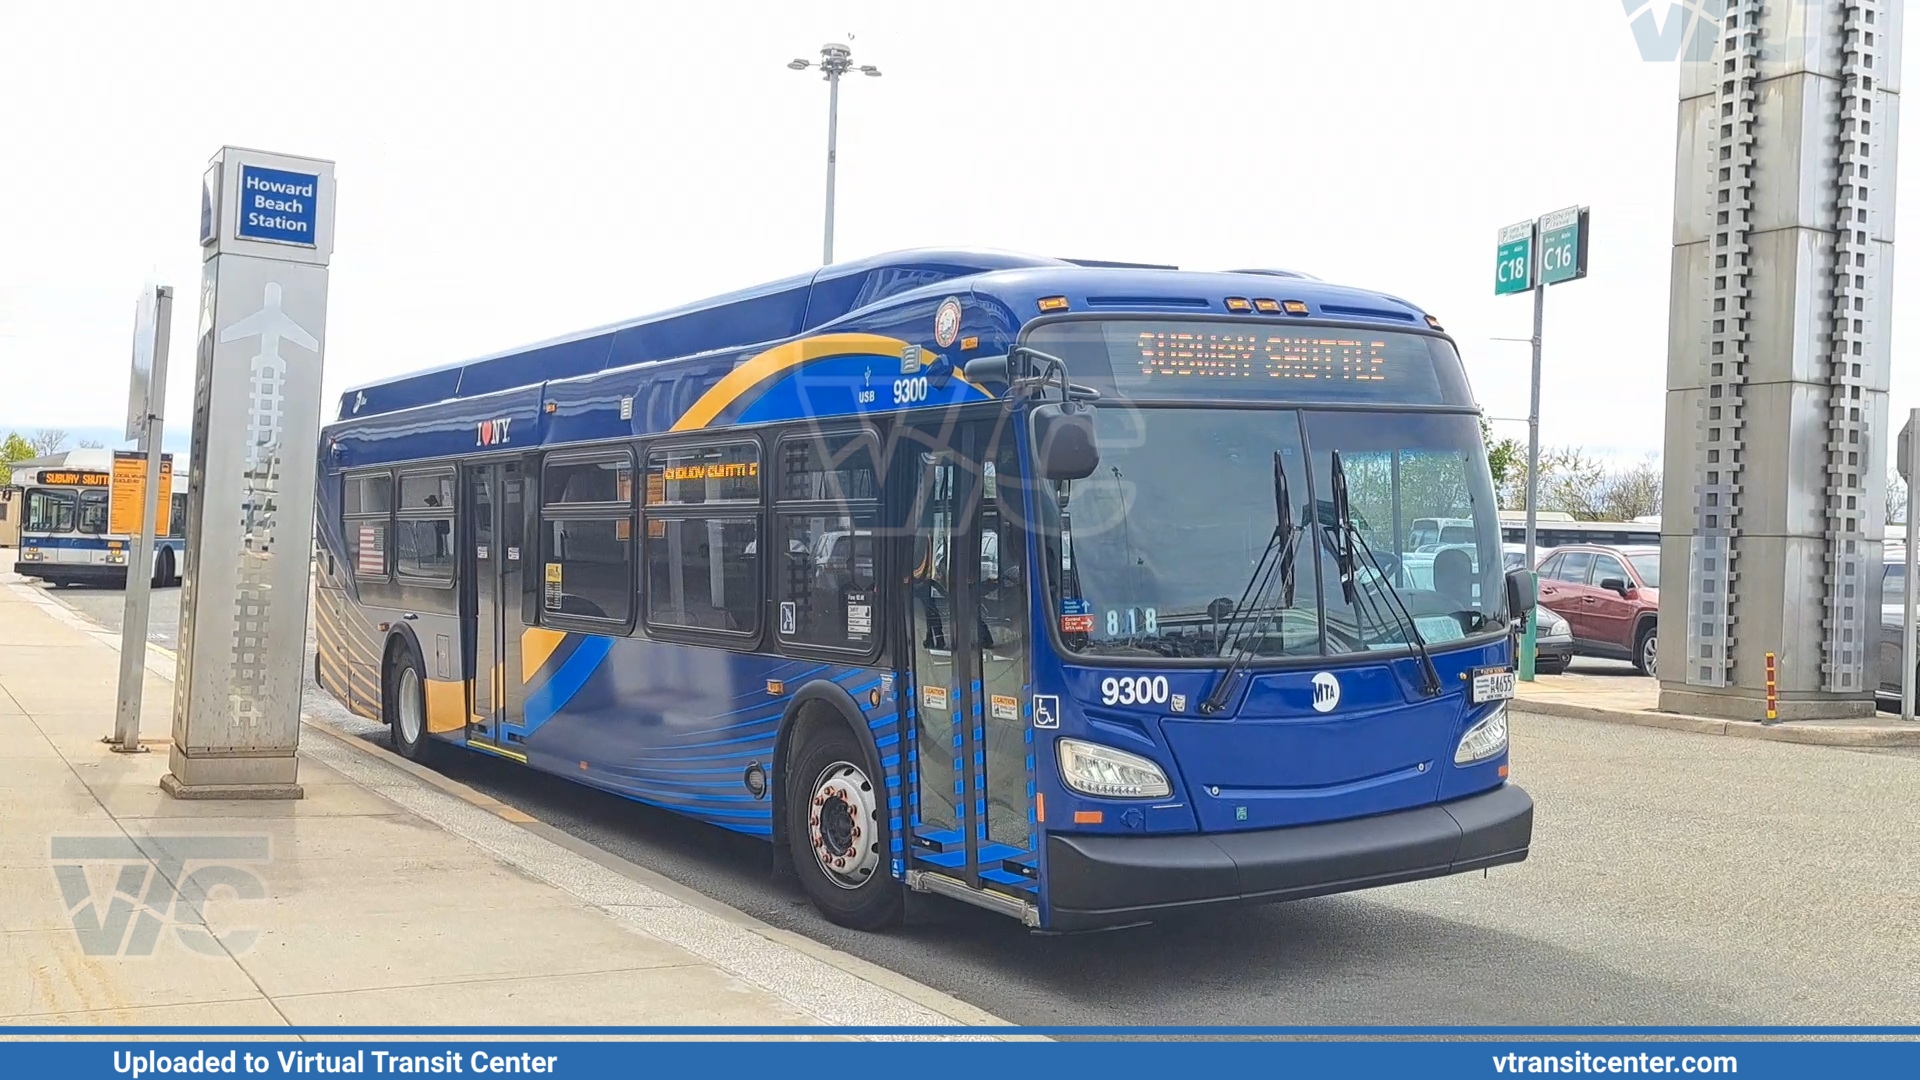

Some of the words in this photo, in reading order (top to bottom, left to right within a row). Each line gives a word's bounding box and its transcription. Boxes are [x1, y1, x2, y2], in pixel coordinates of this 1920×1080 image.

[246, 176, 313, 197] Howard
[254, 195, 303, 213] Beach
[248, 212, 307, 232] Station
[1544, 244, 1571, 270] C16
[1498, 257, 1524, 282] C18
[1138, 333, 1256, 376] SUBWAY
[1265, 337, 1385, 380] SHUTTLE
[859, 391, 875, 403] USB
[893, 376, 928, 404] 9300
[45, 473, 79, 484] SUBWAY
[82, 475, 110, 486] SHUTT
[1101, 675, 1169, 706] 9300
[1312, 682, 1335, 703] MTA
